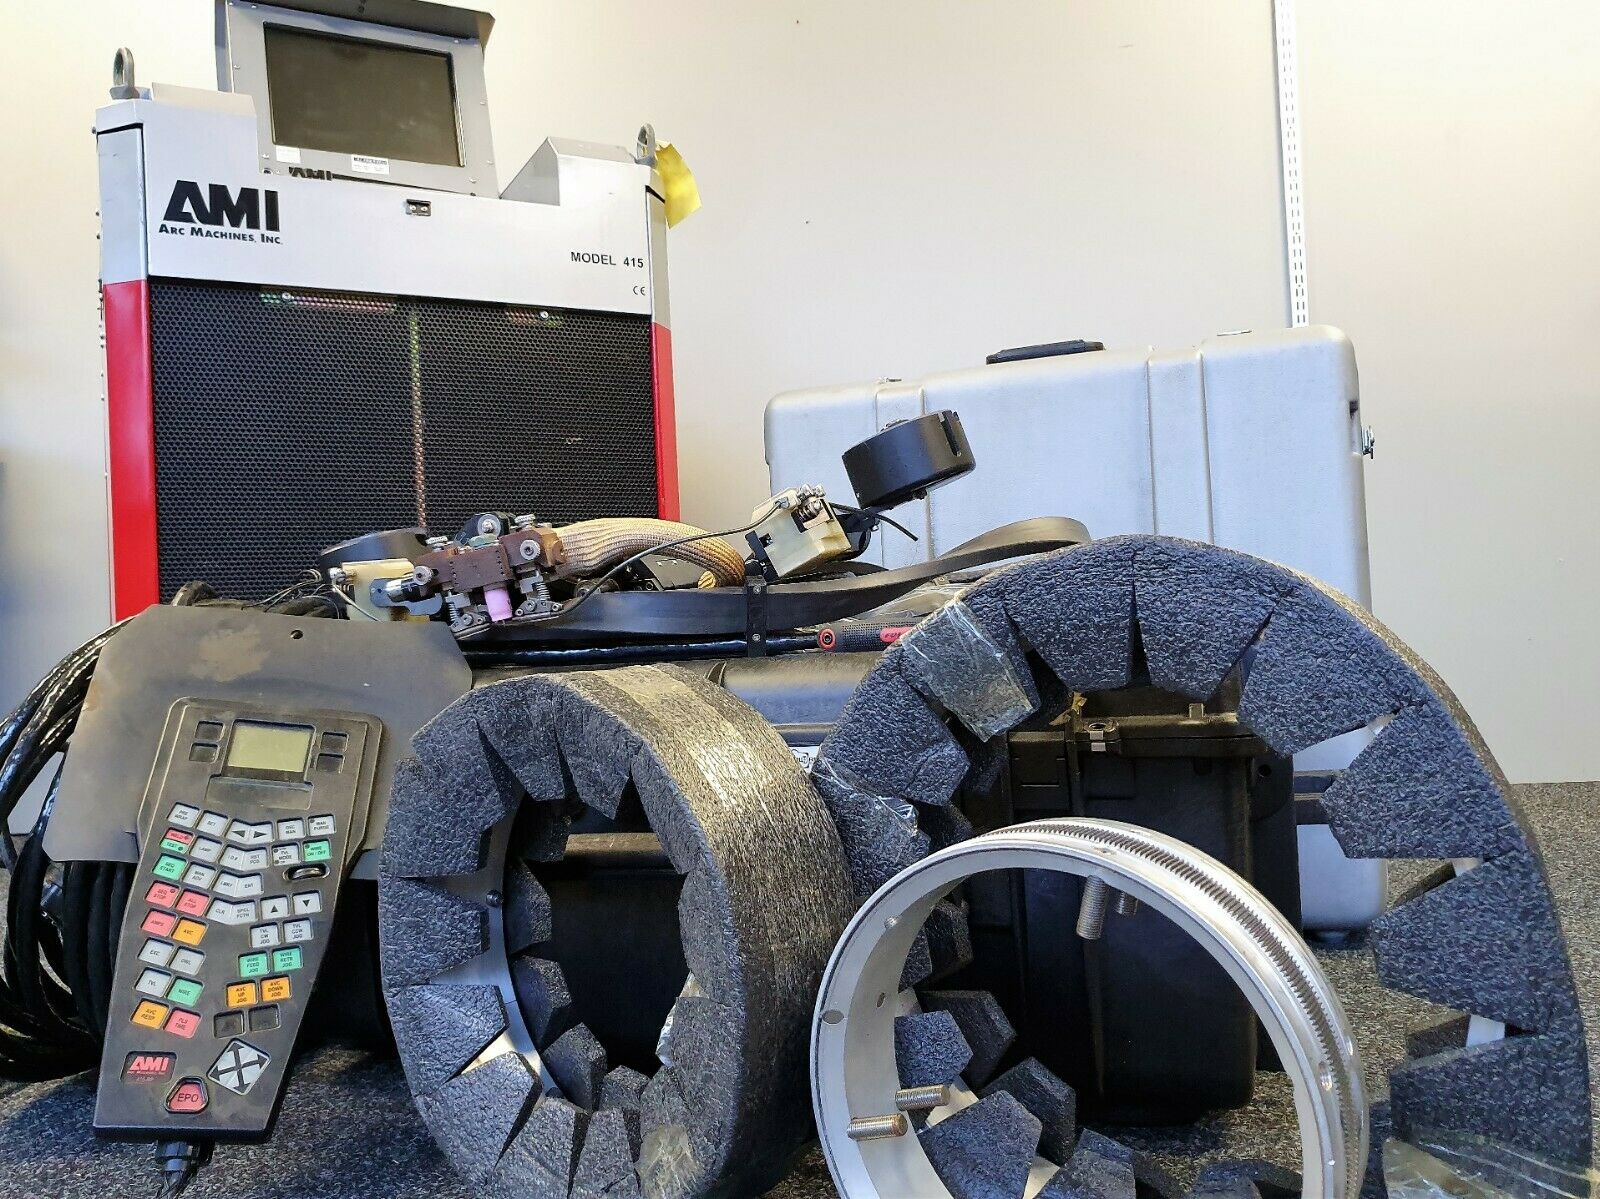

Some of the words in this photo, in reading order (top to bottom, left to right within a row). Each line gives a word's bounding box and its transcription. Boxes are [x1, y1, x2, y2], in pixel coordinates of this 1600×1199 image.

[163, 179, 280, 232] AMI
[570, 251, 617, 266] MODEL
[623, 257, 644, 268] 415
[178, 988, 191, 996] WIRE
[129, 1056, 169, 1071] AMI
[177, 1093, 199, 1102] EPO
